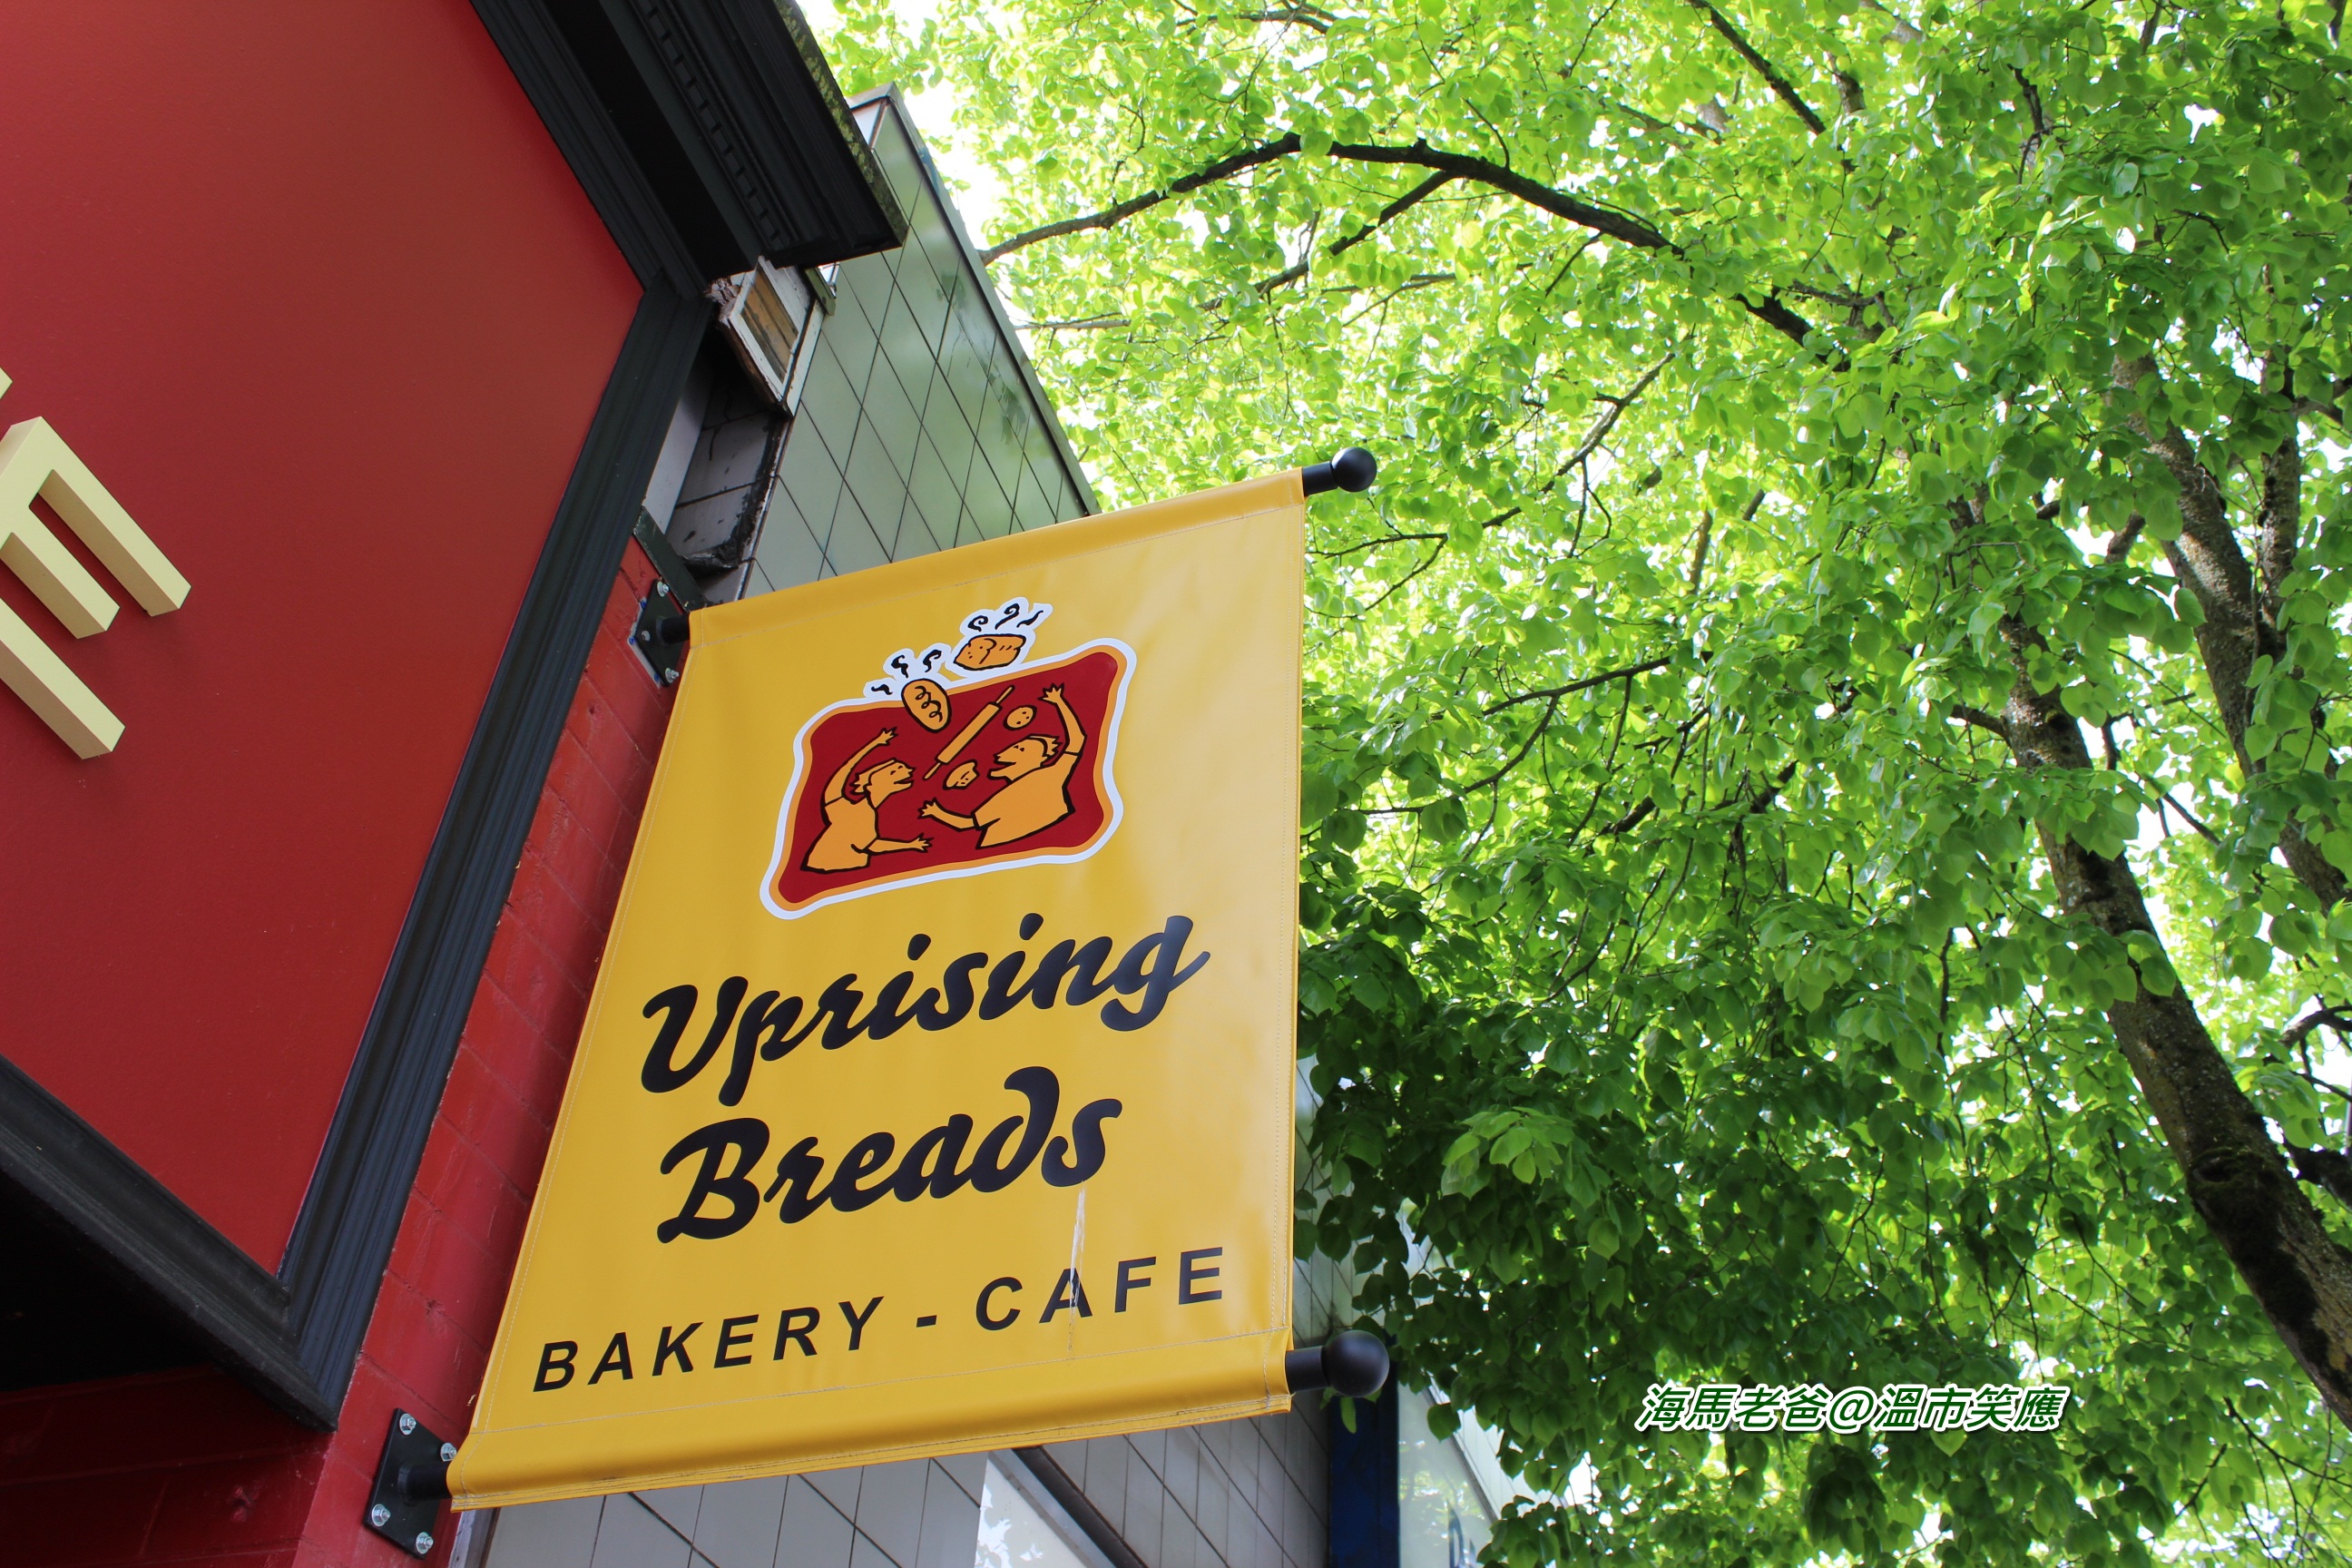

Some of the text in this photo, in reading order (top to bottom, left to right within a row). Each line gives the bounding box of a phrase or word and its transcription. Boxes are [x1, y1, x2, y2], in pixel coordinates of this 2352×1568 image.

[642, 913, 1211, 1107] Uprising
[657, 1065, 1123, 1244] Breads
[533, 1296, 885, 1393] BAKERY
[975, 1247, 1224, 1331] CAFE
